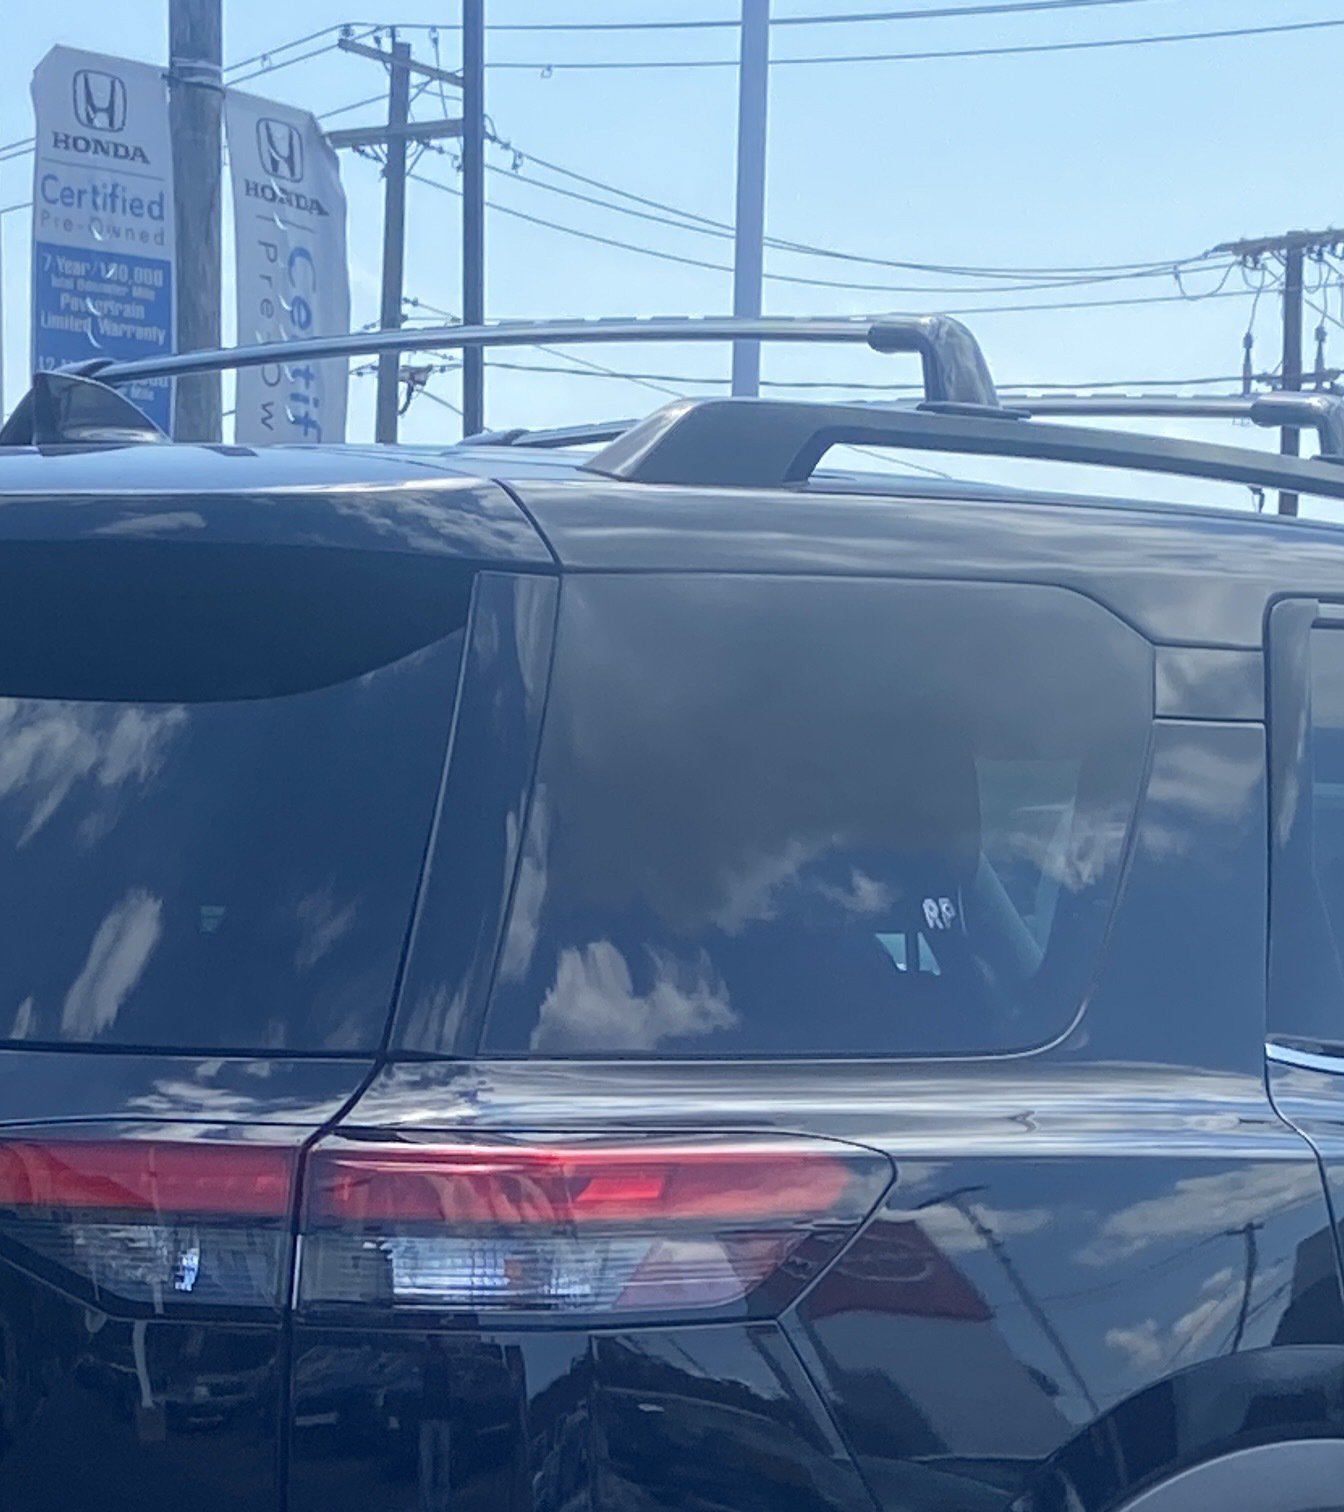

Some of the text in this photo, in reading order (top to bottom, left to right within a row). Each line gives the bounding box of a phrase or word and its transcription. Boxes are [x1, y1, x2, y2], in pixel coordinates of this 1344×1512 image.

[52, 131, 151, 165] HONDA
[41, 174, 165, 222] Certified
[244, 178, 330, 217] HONDA
[41, 209, 165, 247] Pre-Owned
[41, 252, 52, 272] 7
[97, 317, 167, 347] Warranty
[287, 246, 323, 444] Cetif
